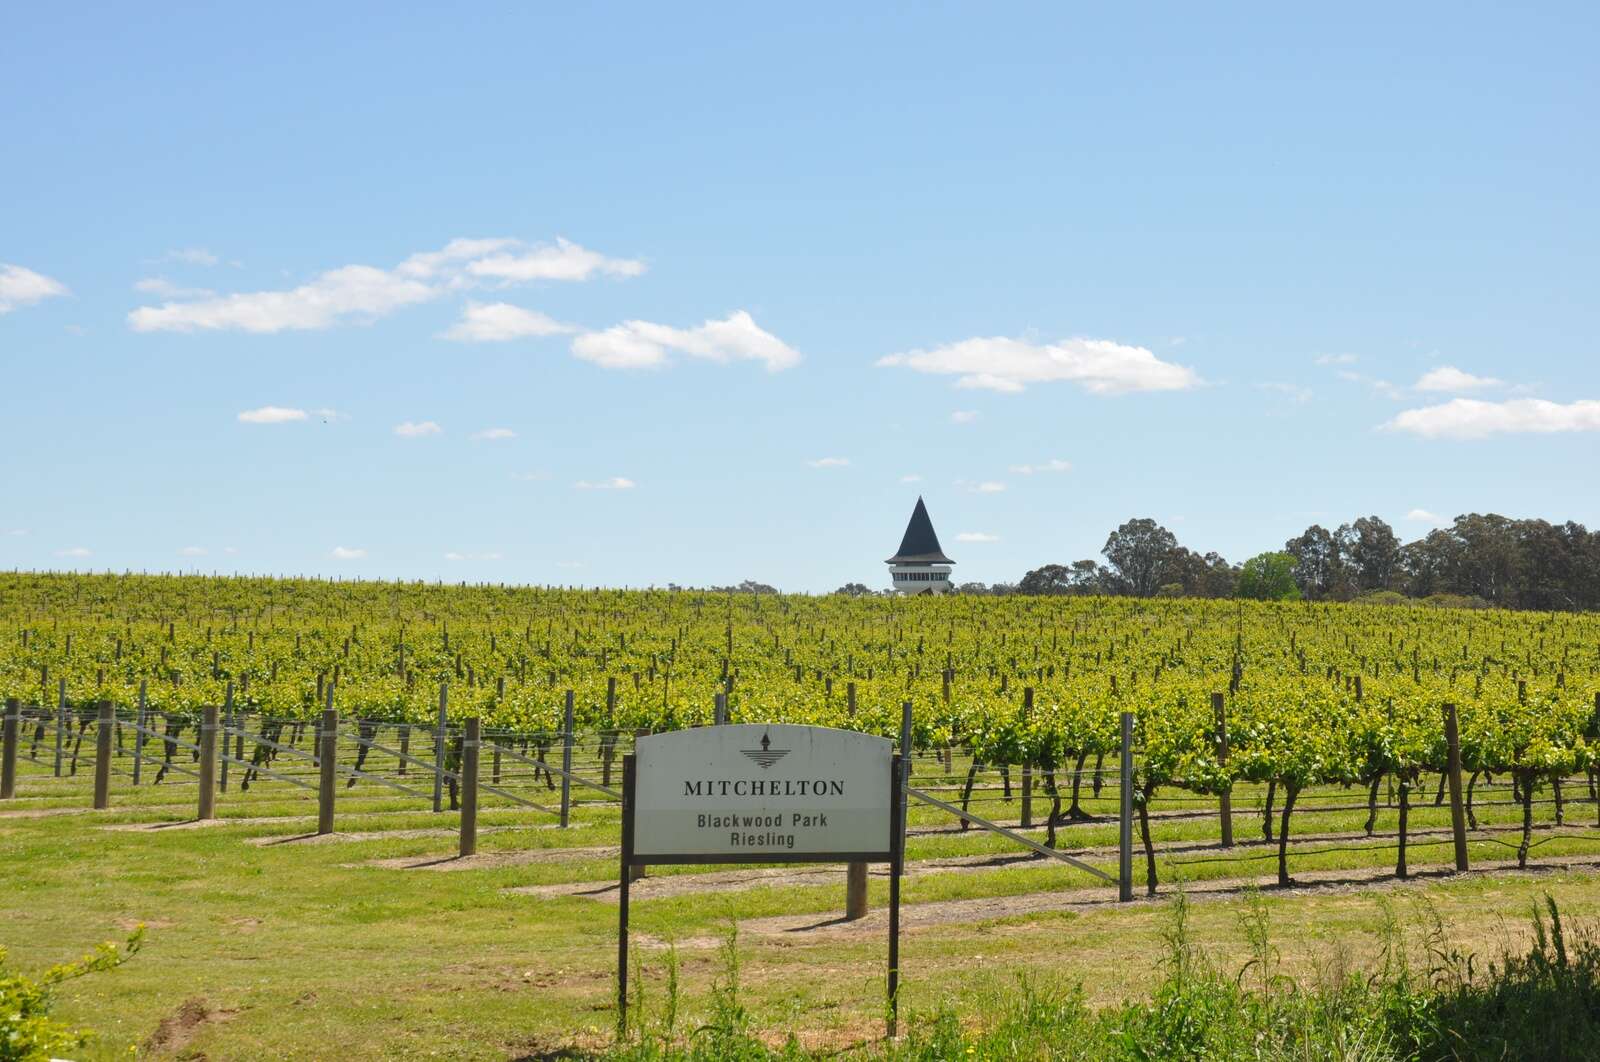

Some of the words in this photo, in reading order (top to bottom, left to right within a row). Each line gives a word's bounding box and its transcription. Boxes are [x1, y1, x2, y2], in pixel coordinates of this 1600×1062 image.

[684, 780, 845, 796] MITCHELTON
[697, 814, 782, 828] Blackwood
[792, 813, 828, 827] Park
[730, 832, 795, 848] Riesling
